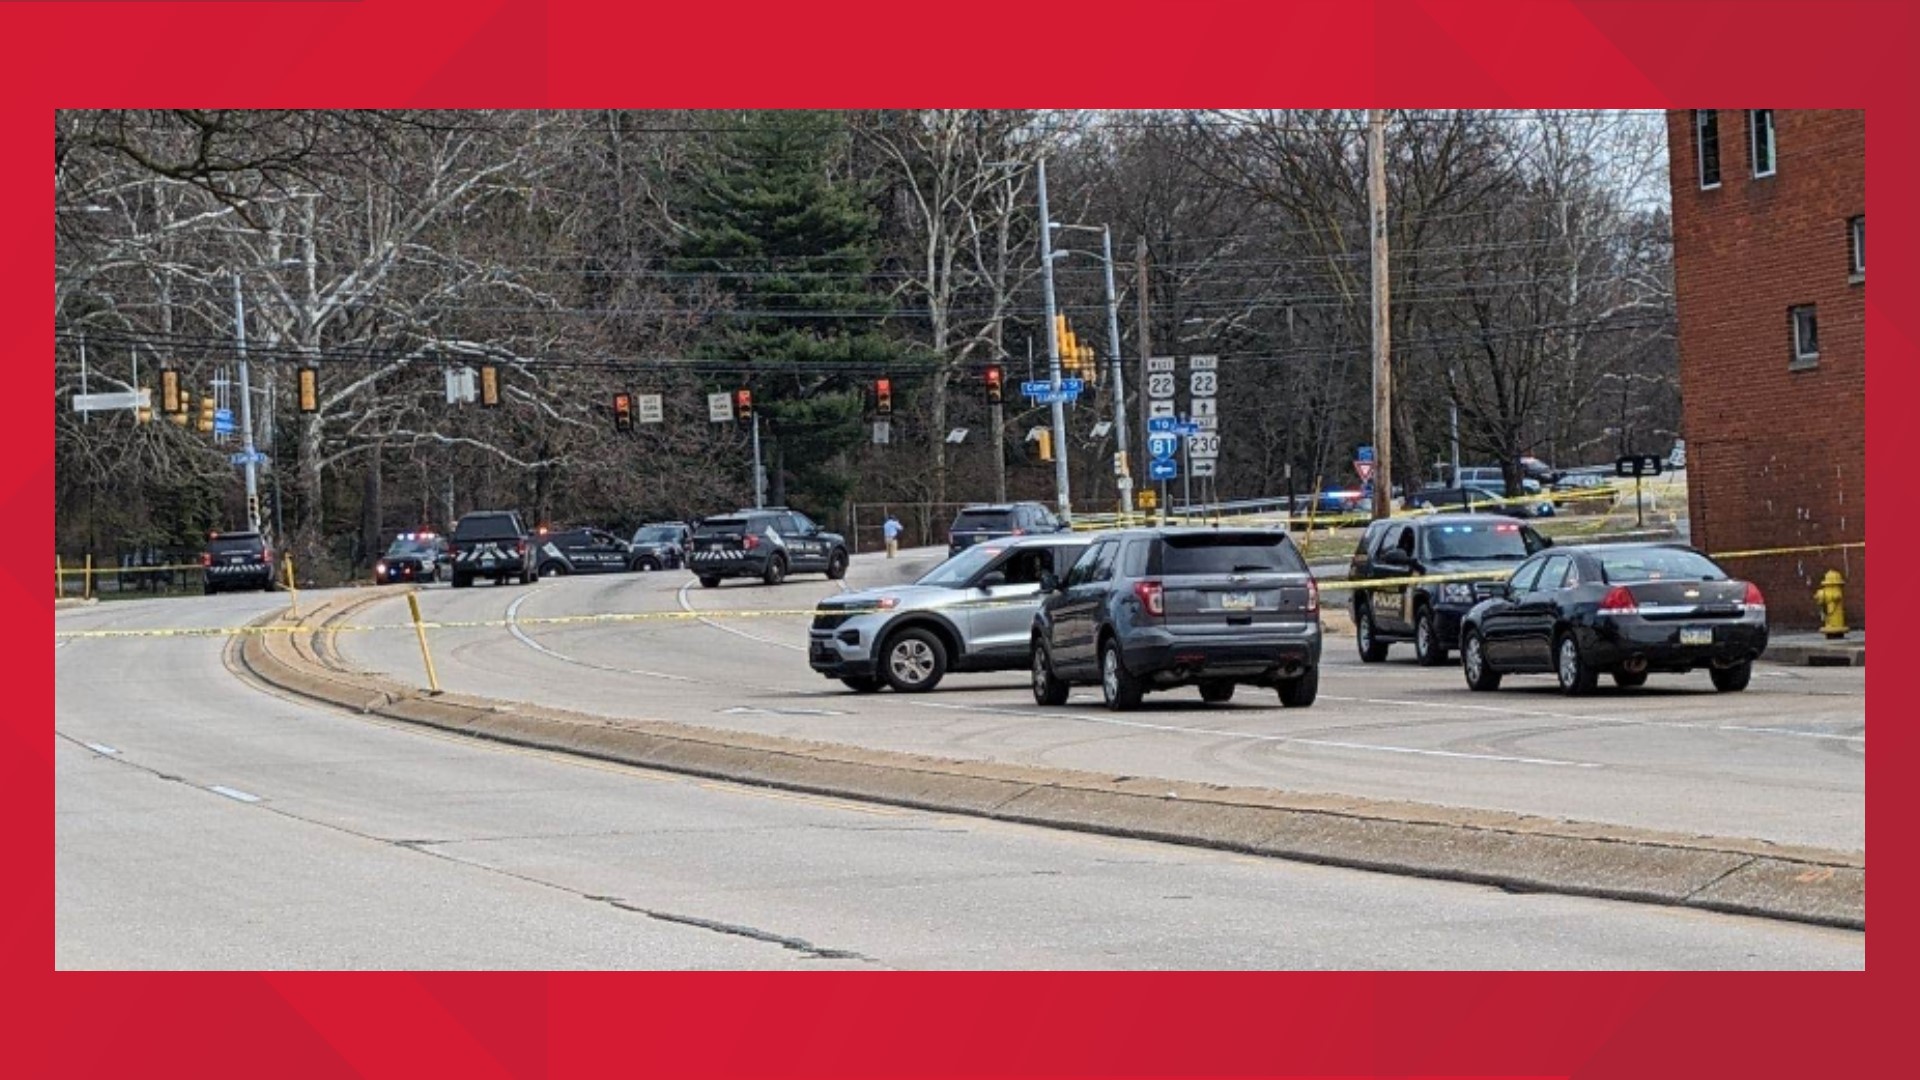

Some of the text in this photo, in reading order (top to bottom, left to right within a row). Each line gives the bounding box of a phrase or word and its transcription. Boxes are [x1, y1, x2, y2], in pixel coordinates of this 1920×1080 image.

[1026, 382, 1067, 392] Camen
[1151, 378, 1171, 393] 22
[1195, 376, 1213, 391] 22
[1155, 420, 1170, 429] TO
[1153, 440, 1171, 454] 81
[1190, 437, 1219, 451] 230
[1373, 591, 1402, 609] POLICE
